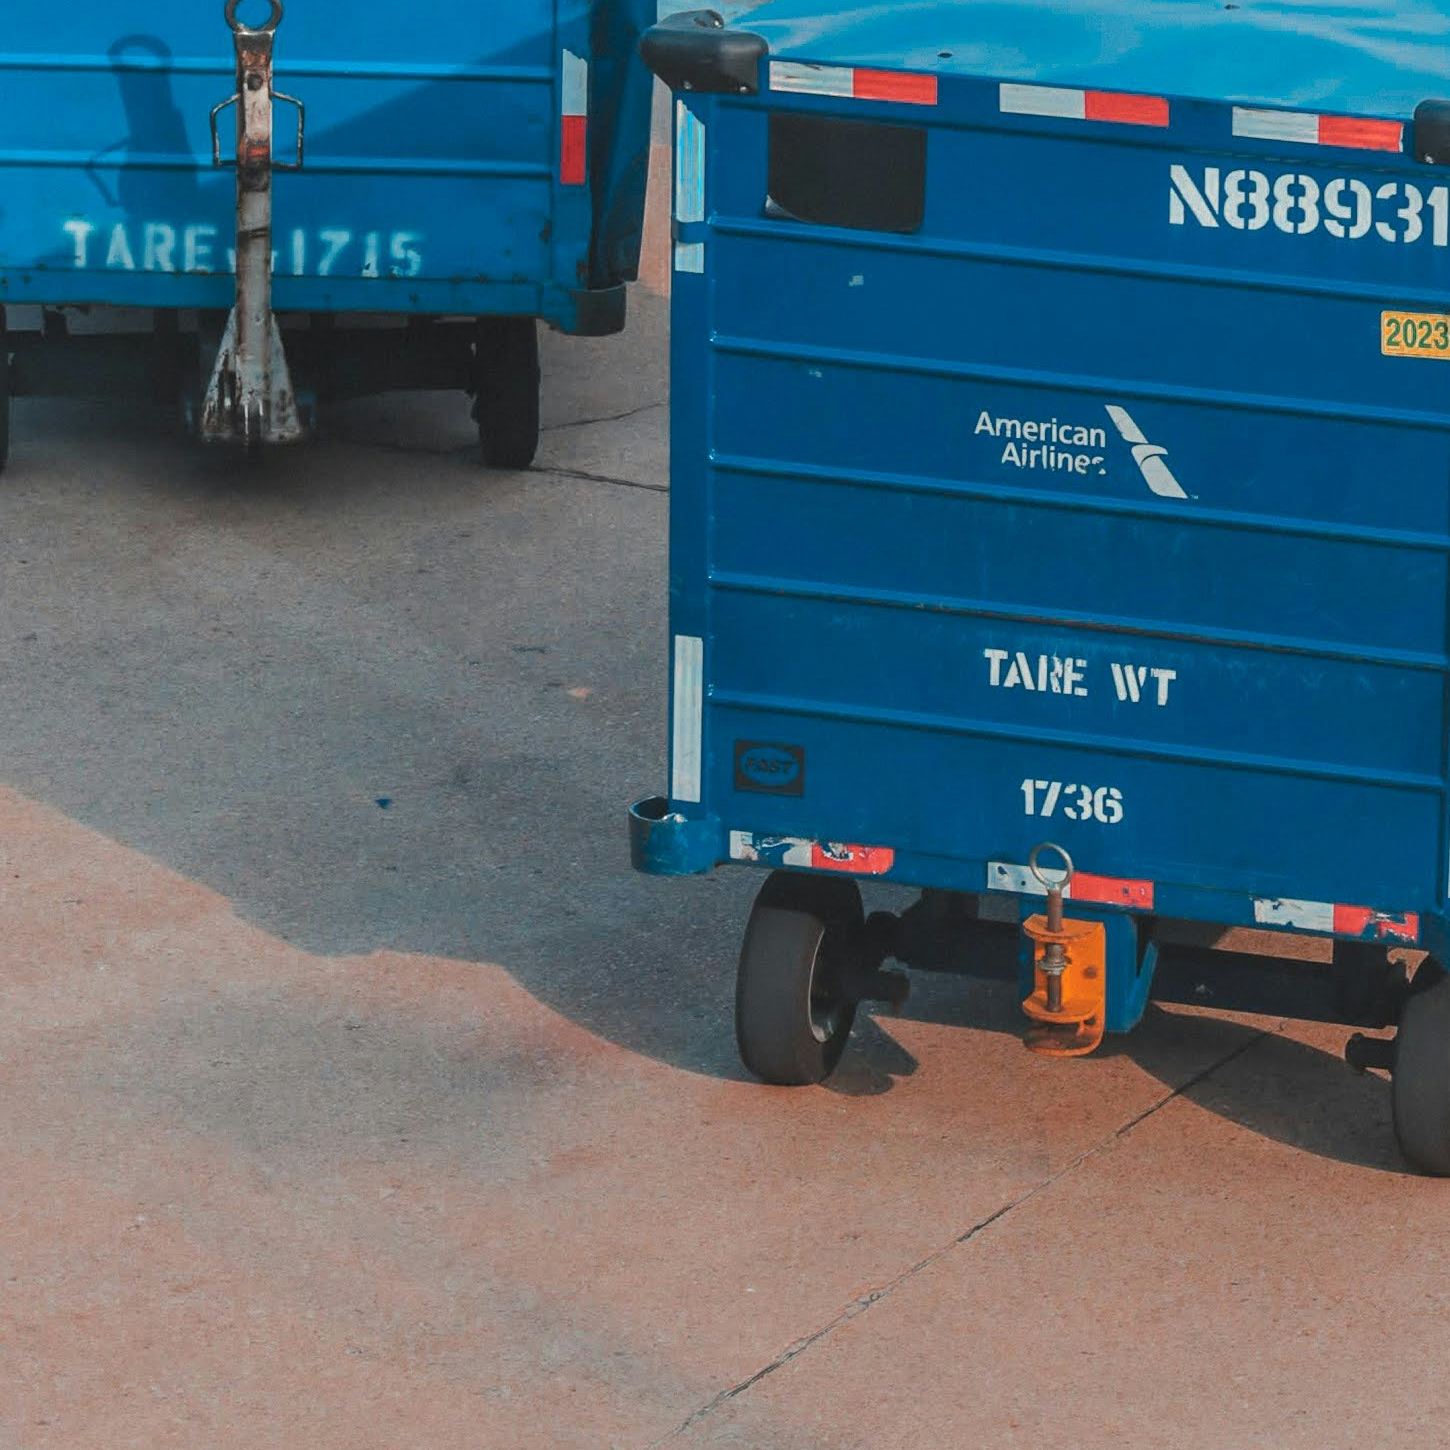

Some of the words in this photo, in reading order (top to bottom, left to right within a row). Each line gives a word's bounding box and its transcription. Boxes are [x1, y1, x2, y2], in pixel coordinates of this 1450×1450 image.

[1169, 164, 1449, 247] N88931
[63, 219, 217, 273] TARE
[292, 228, 421, 278] 1715
[1385, 317, 1449, 351] 2023
[974, 411, 1106, 447] American
[984, 648, 1089, 697] TARE
[1110, 662, 1177, 706] WT
[1020, 778, 1124, 824] 1736
